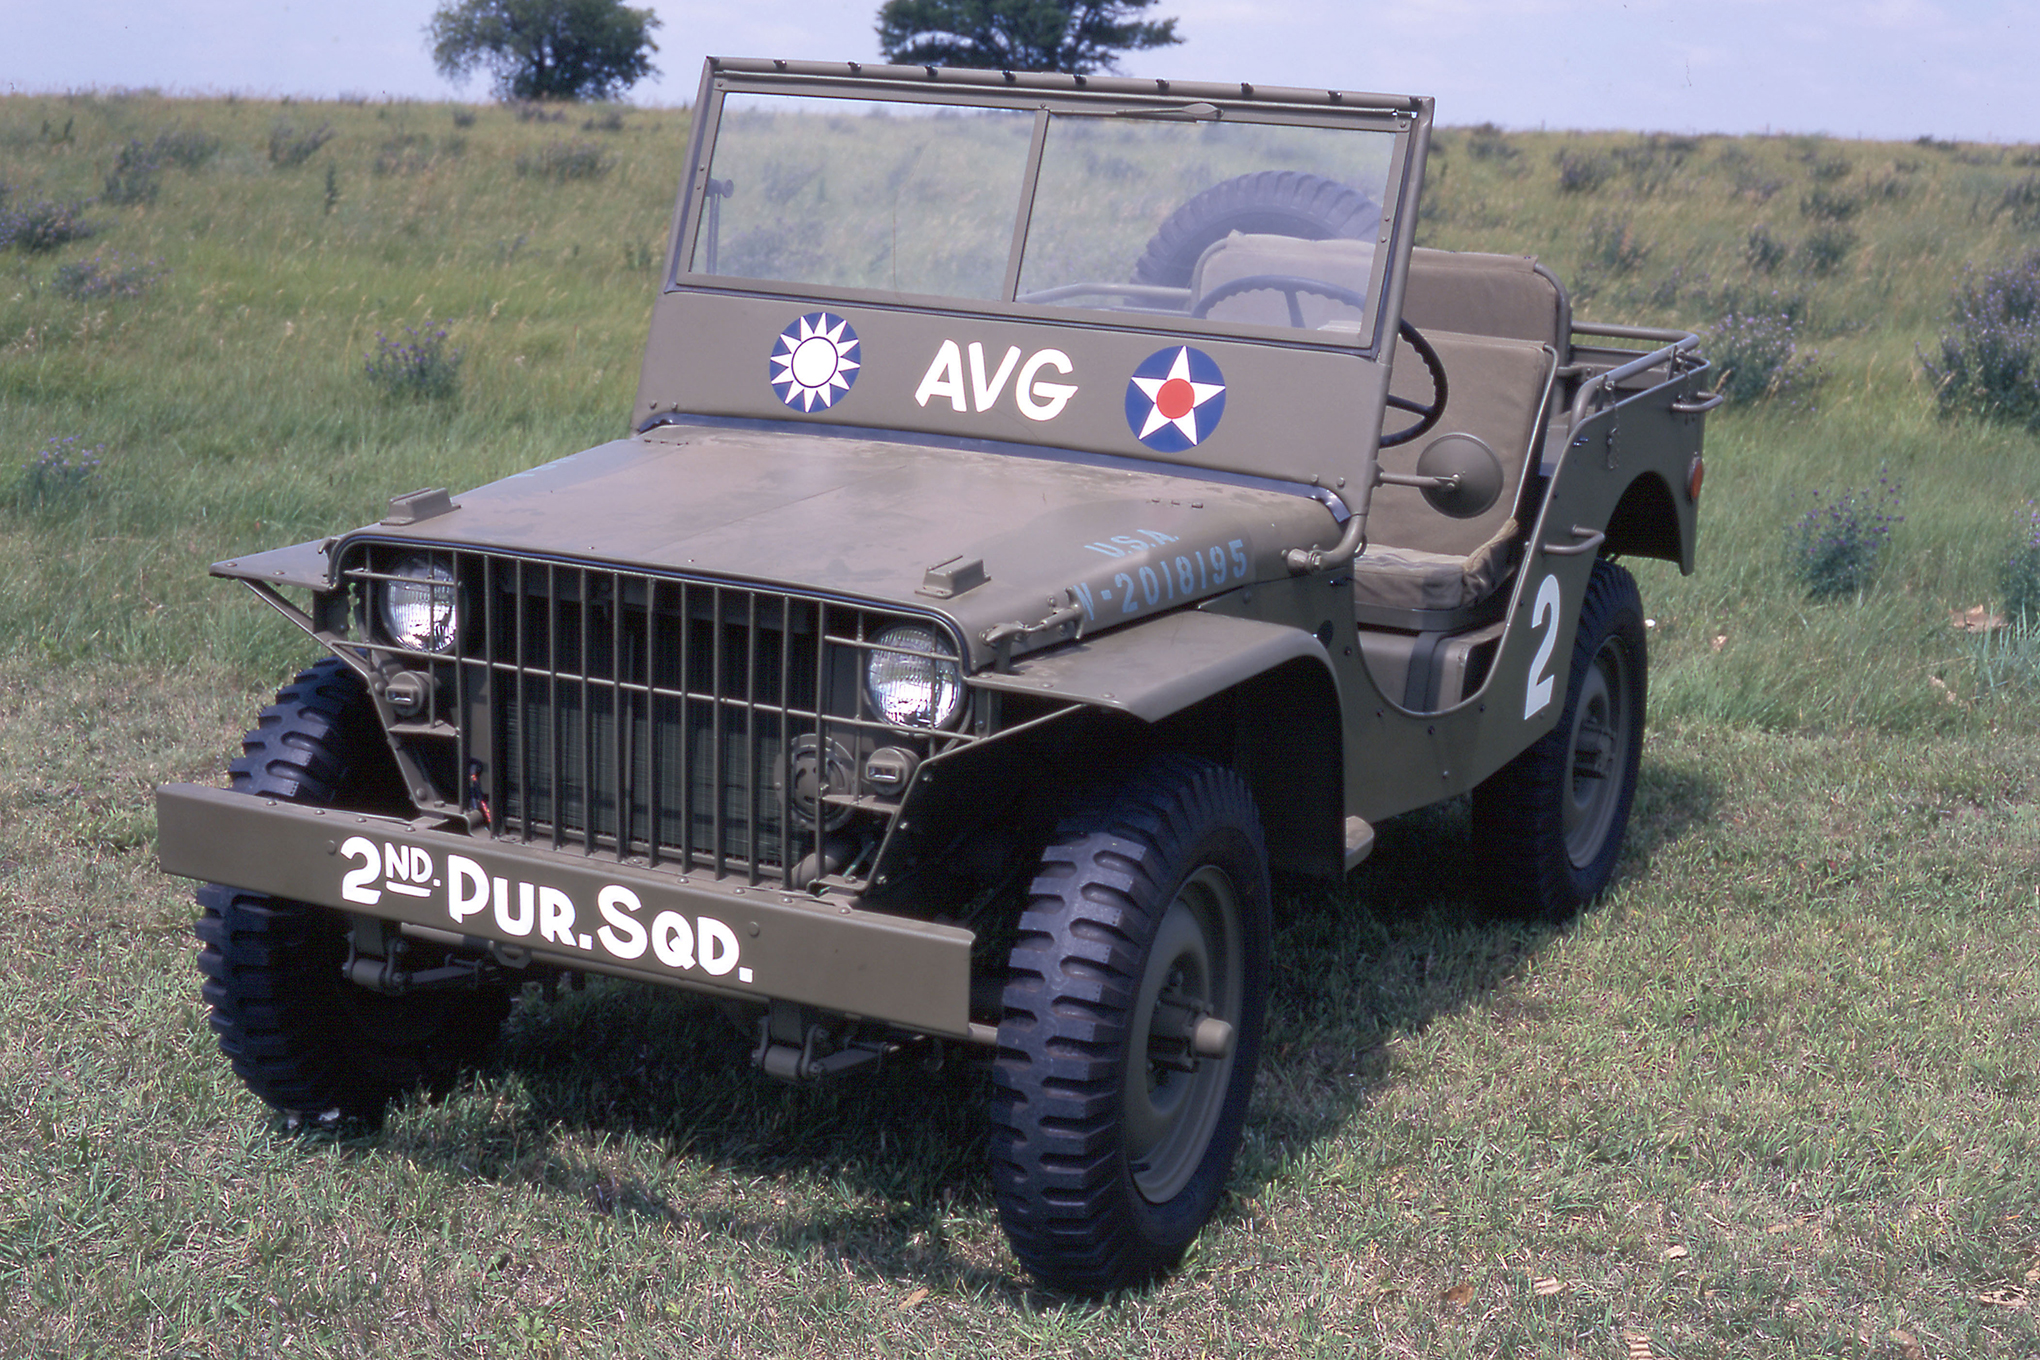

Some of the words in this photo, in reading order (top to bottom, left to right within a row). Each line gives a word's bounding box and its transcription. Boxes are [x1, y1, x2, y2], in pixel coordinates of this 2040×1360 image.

[915, 339, 1078, 421] AVG
[1084, 529, 1179, 558] U.S.A.
[1524, 574, 1560, 720] 2
[448, 854, 593, 950] PUR.
[597, 884, 754, 984] SQD.
